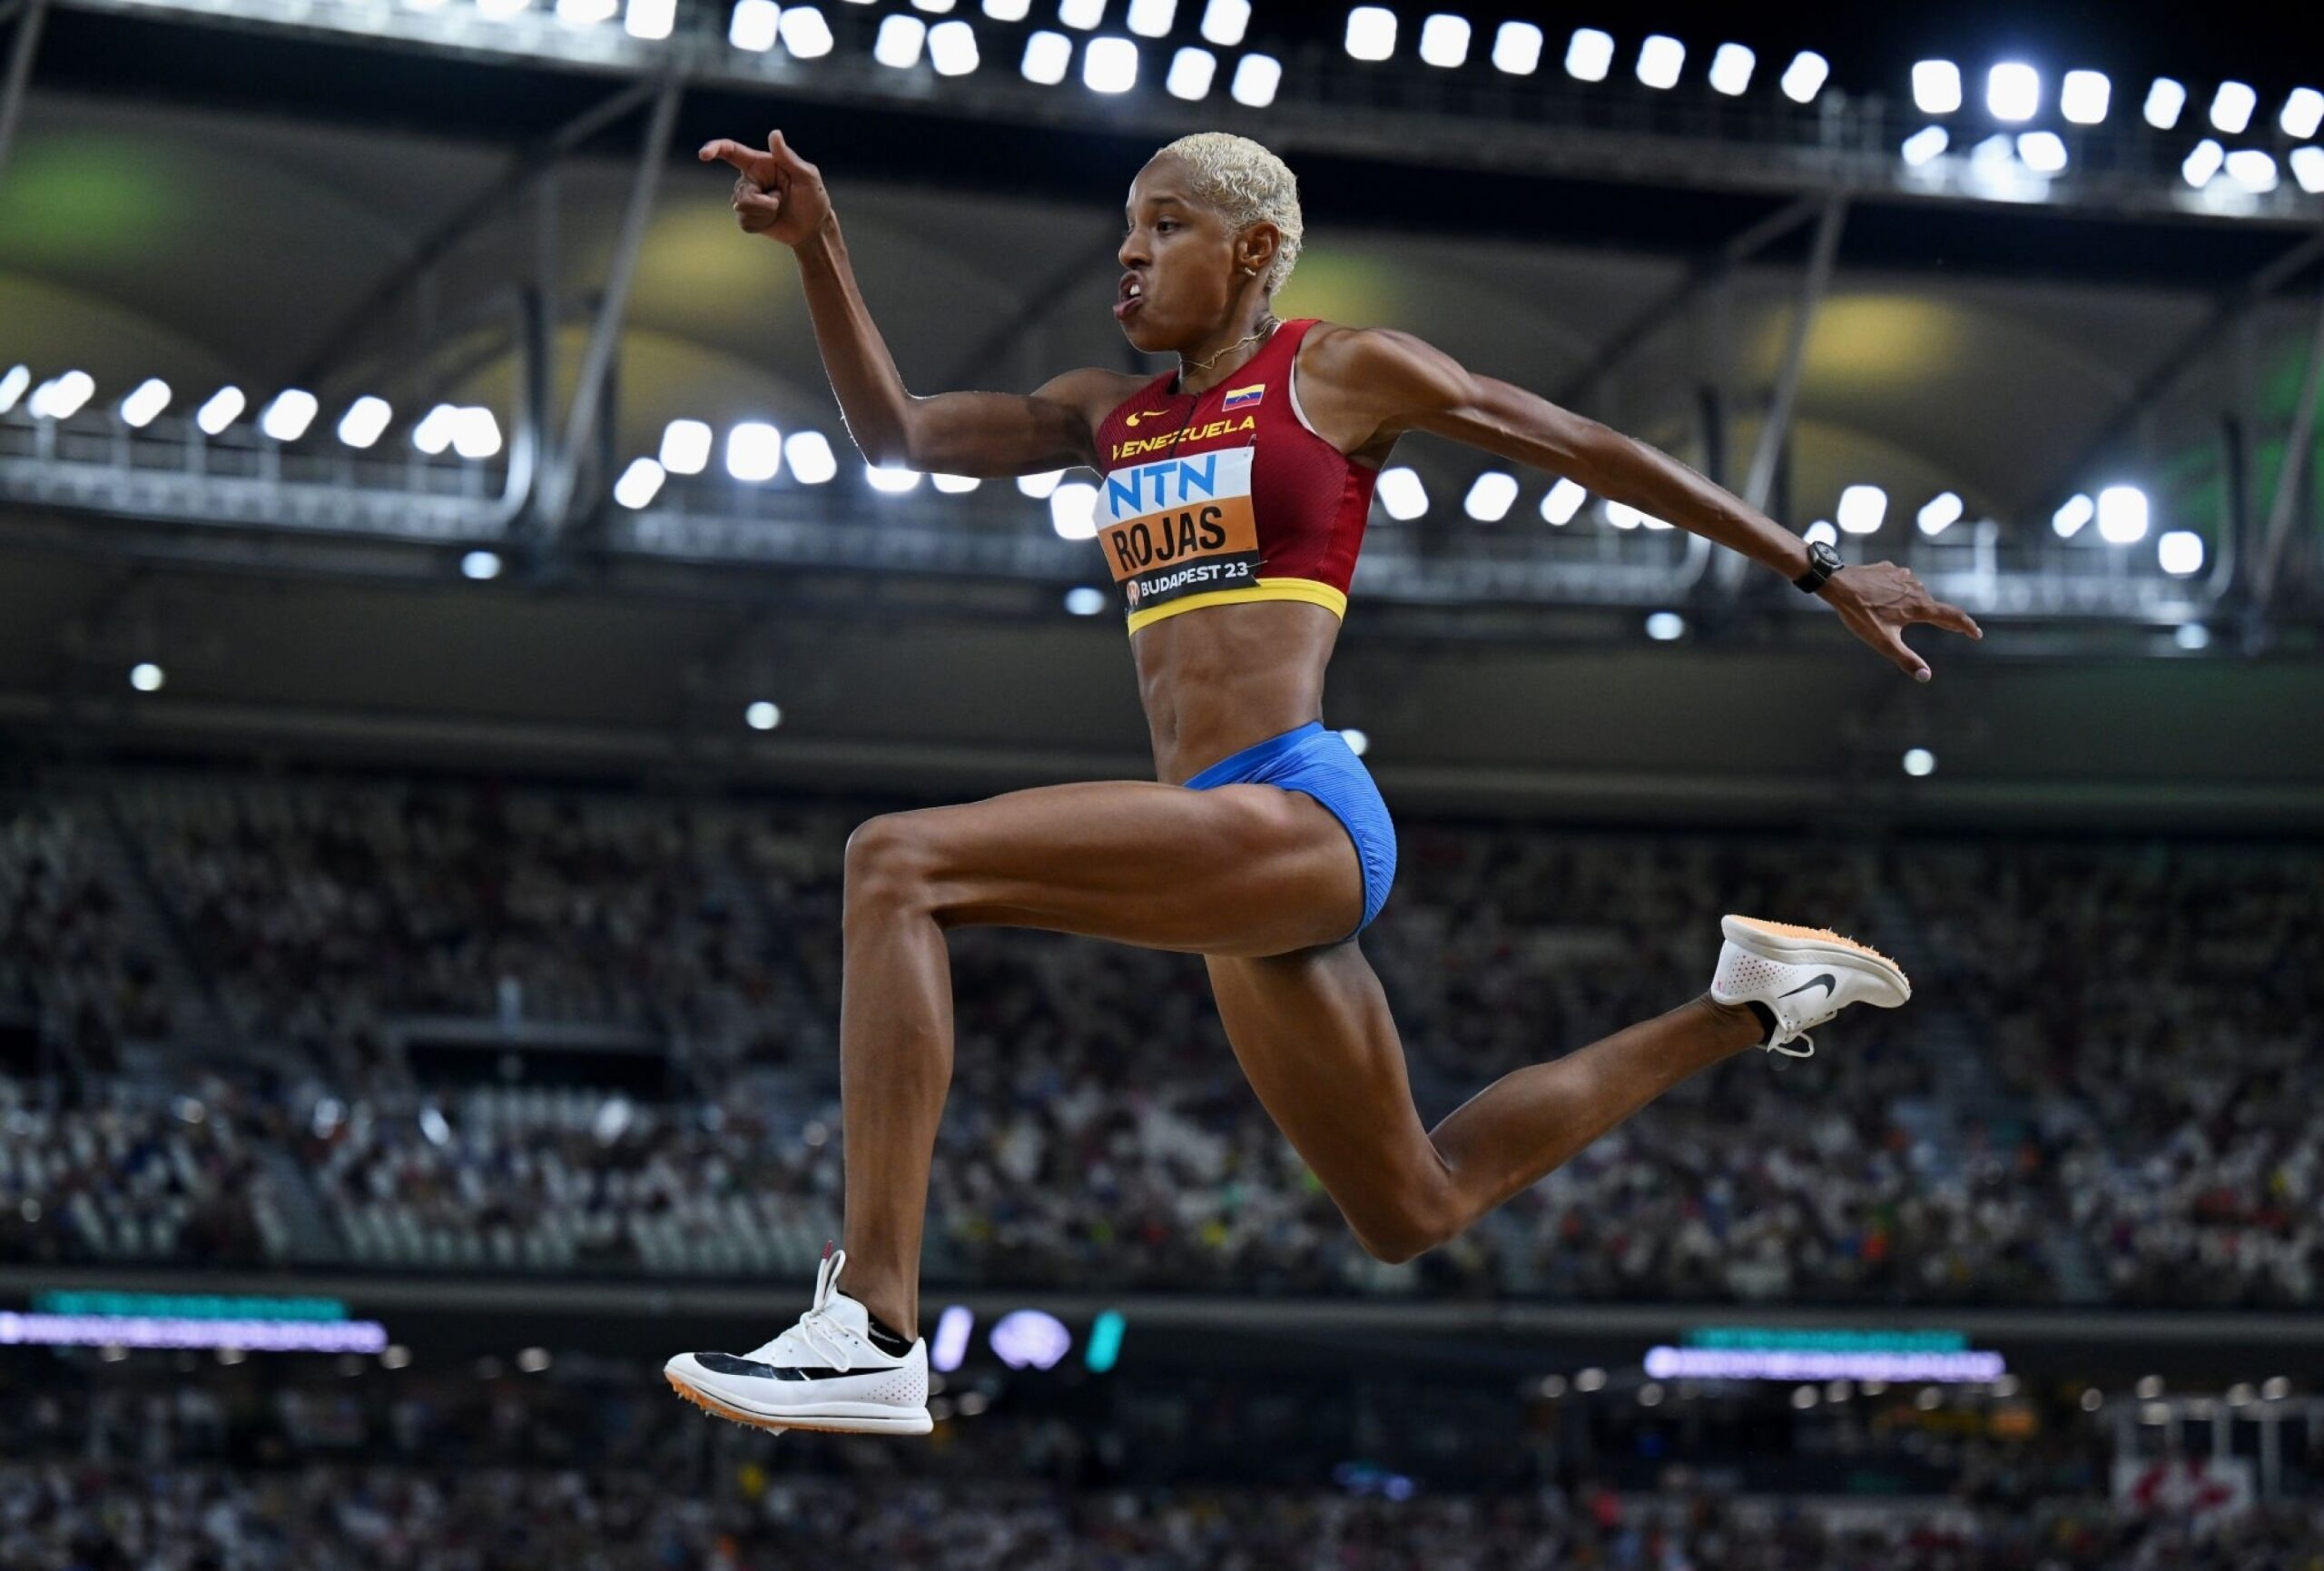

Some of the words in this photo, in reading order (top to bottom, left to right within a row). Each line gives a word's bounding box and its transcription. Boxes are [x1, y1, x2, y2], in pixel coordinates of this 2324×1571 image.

[1112, 415, 1256, 460] VENEZUELA
[1107, 454, 1216, 519] NTN
[1112, 506, 1226, 572] ROJAS
[1140, 564, 1221, 598] BUDAPEST
[1224, 561, 1248, 578] 23
